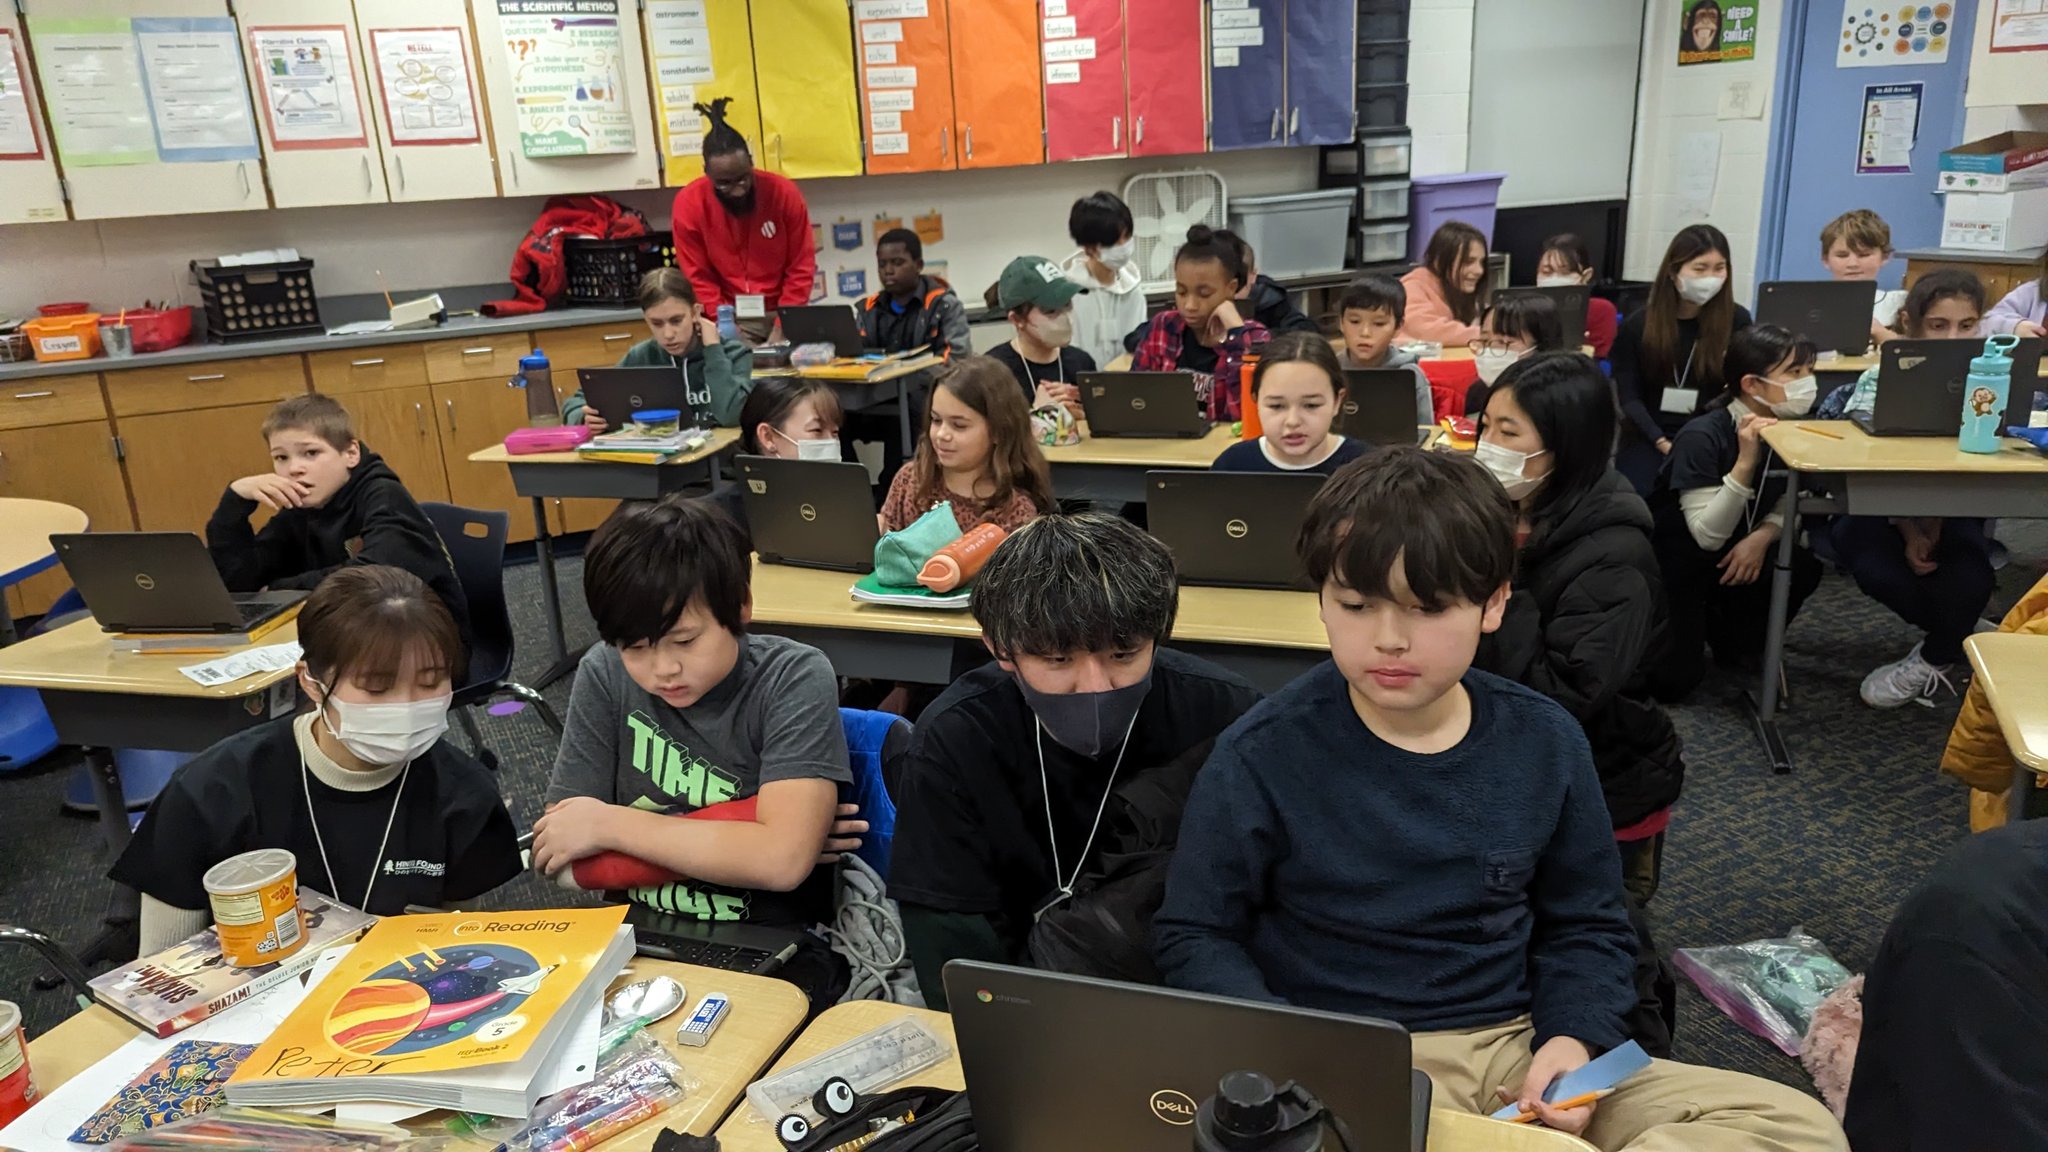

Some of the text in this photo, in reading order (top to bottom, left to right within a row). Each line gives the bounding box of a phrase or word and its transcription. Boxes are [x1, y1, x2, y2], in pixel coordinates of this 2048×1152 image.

[500, 1, 616, 12] THE SCIENTIFIC METHOD
[655, 10, 700, 19] astronomer
[1726, 5, 1754, 20] NEED
[505, 27, 548, 36] QUESTION
[1722, 27, 1755, 42] SMILE?
[669, 37, 695, 46] model
[534, 64, 585, 74] HYPOTHESIS
[661, 65, 711, 76] constellation
[522, 84, 573, 94] EXPERIMENT
[529, 105, 565, 114] ANALYZE
[627, 709, 743, 808] TIME
[483, 919, 571, 933] Reading
[208, 985, 251, 1015] SHAZAM!
[255, 981, 266, 989] THE
[267, 970, 288, 983] DELUXE
[290, 960, 310, 973] JUNIOR
[492, 1027, 506, 1036] 5
[262, 1046, 426, 1078] Peter
[1156, 1099, 1194, 1116] DELL
